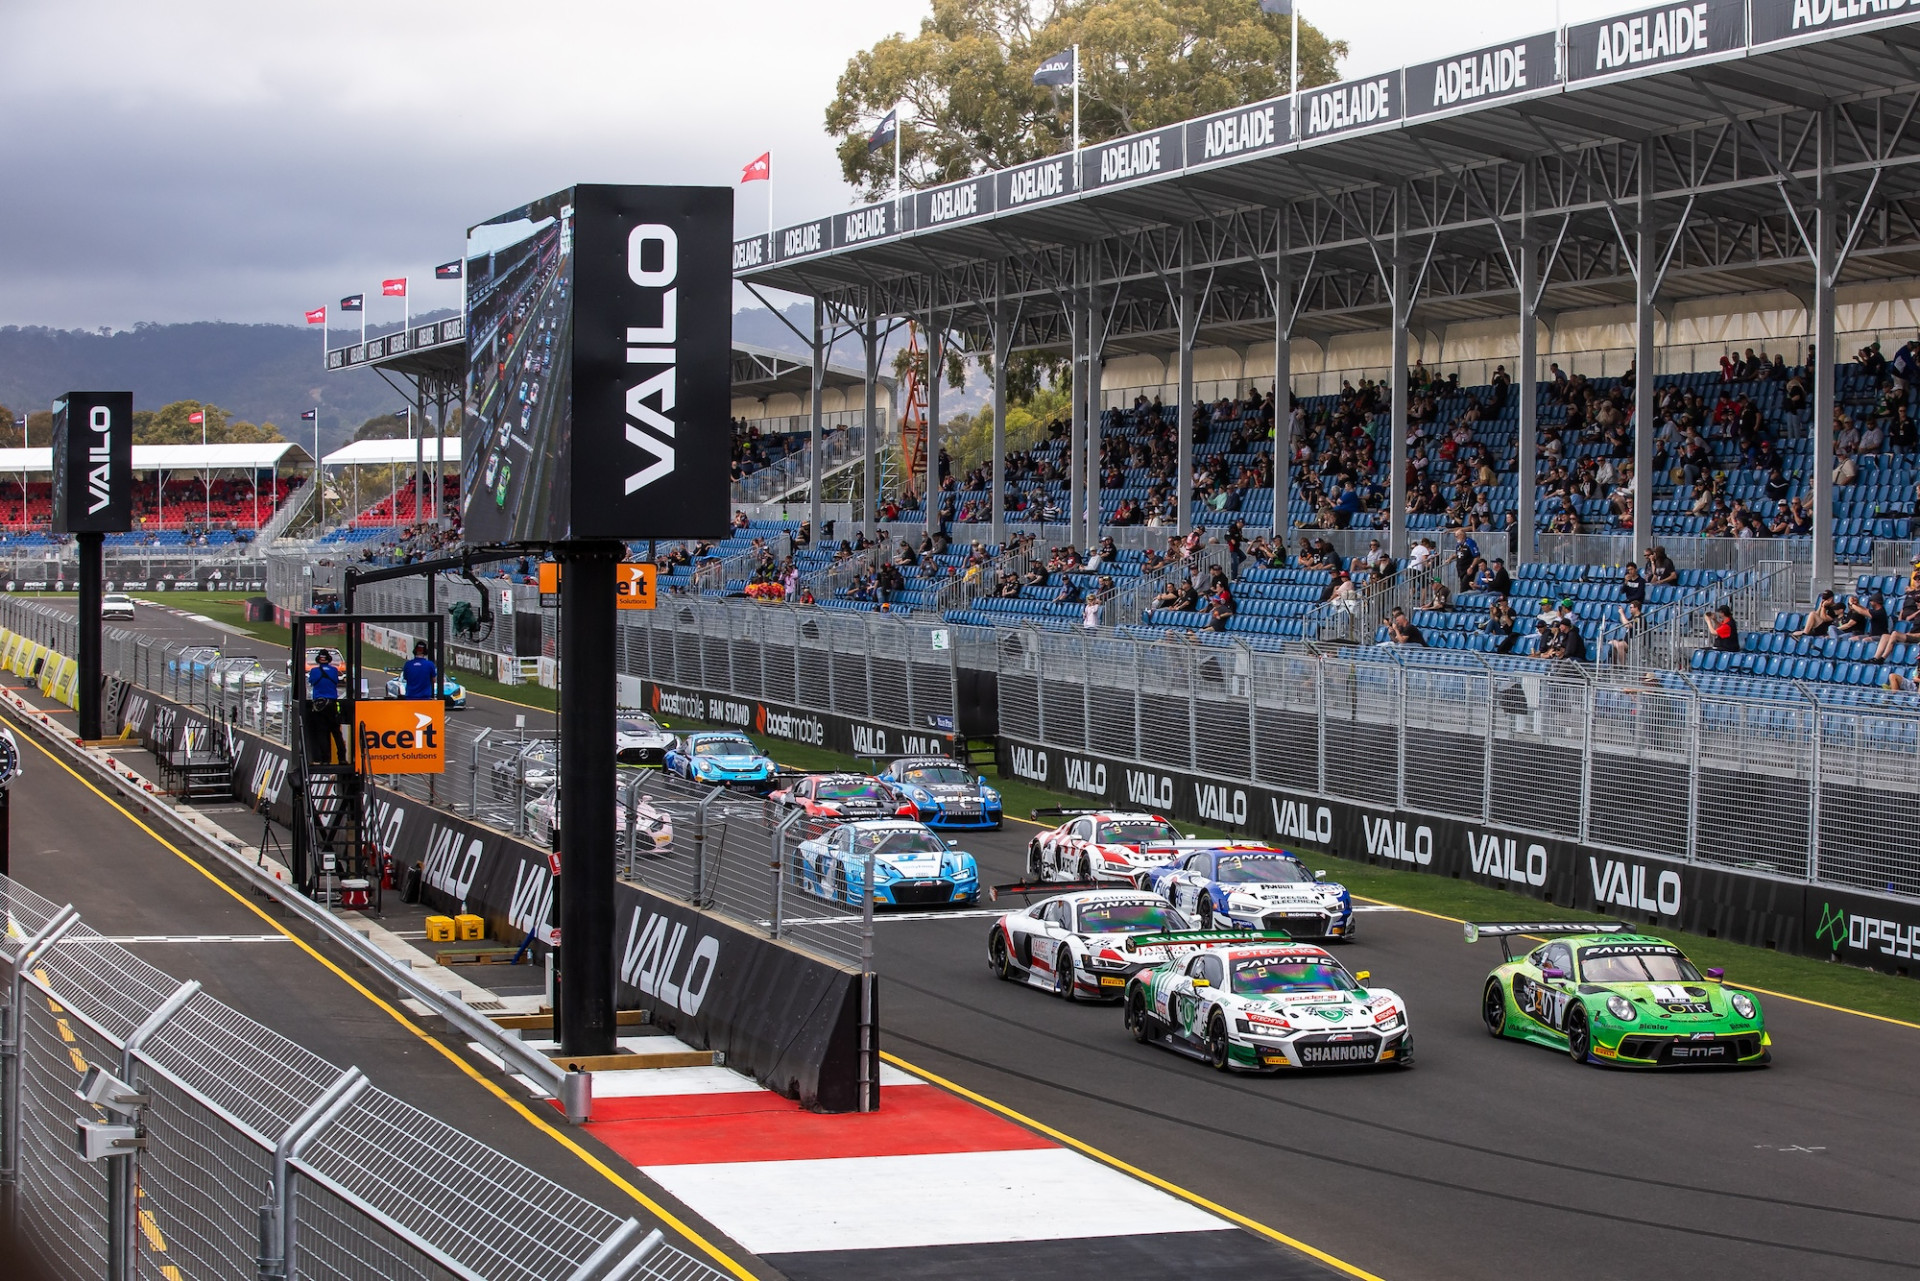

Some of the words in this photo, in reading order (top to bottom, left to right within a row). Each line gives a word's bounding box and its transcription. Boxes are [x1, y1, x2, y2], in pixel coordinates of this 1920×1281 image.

[1596, 6, 1708, 70] ADELAIDE
[1433, 44, 1527, 106] ADELAIDE
[1309, 79, 1389, 133] ADELAIDE
[1204, 106, 1274, 158] ADELAIDE
[1100, 136, 1161, 183] ADELAIDE
[1010, 161, 1063, 204] ADELAIDE
[846, 203, 886, 242] ADELAIDE
[930, 183, 977, 224] ADELAIDE
[733, 239, 762, 269] DELAIDE
[785, 224, 821, 257] ADELAIDE
[625, 223, 678, 496] VAILO
[88, 405, 111, 515] VAILO
[616, 567, 647, 596] eit
[709, 699, 723, 720] FAN
[725, 702, 749, 726] STAND
[851, 724, 886, 754] VAILO
[1011, 745, 1048, 782] VAILO
[1065, 757, 1107, 795] VAILO
[1126, 769, 1173, 810] VAILO
[1195, 783, 1247, 825] VAILO
[1100, 820, 1170, 830] FANATEC
[1272, 798, 1333, 844] VAILO
[1362, 815, 1433, 865] VAILO
[420, 822, 483, 900] VAILO
[1219, 854, 1298, 864] FANATEC
[1234, 859, 1242, 868] 3
[1468, 831, 1547, 887] VAILO
[508, 857, 554, 947] VAIL
[1589, 856, 1681, 916] VAILO
[1081, 900, 1168, 913] FANATEC
[1101, 910, 1110, 918] 4
[620, 905, 720, 1018] VAILO
[1236, 957, 1333, 971] FANATEC
[1584, 946, 1679, 956] FANATEC
[1257, 967, 1267, 978] 2
[1668, 1003, 1710, 1013] OTR
[1303, 1044, 1375, 1062] SHANNONS
[1671, 1046, 1725, 1057] EMA
